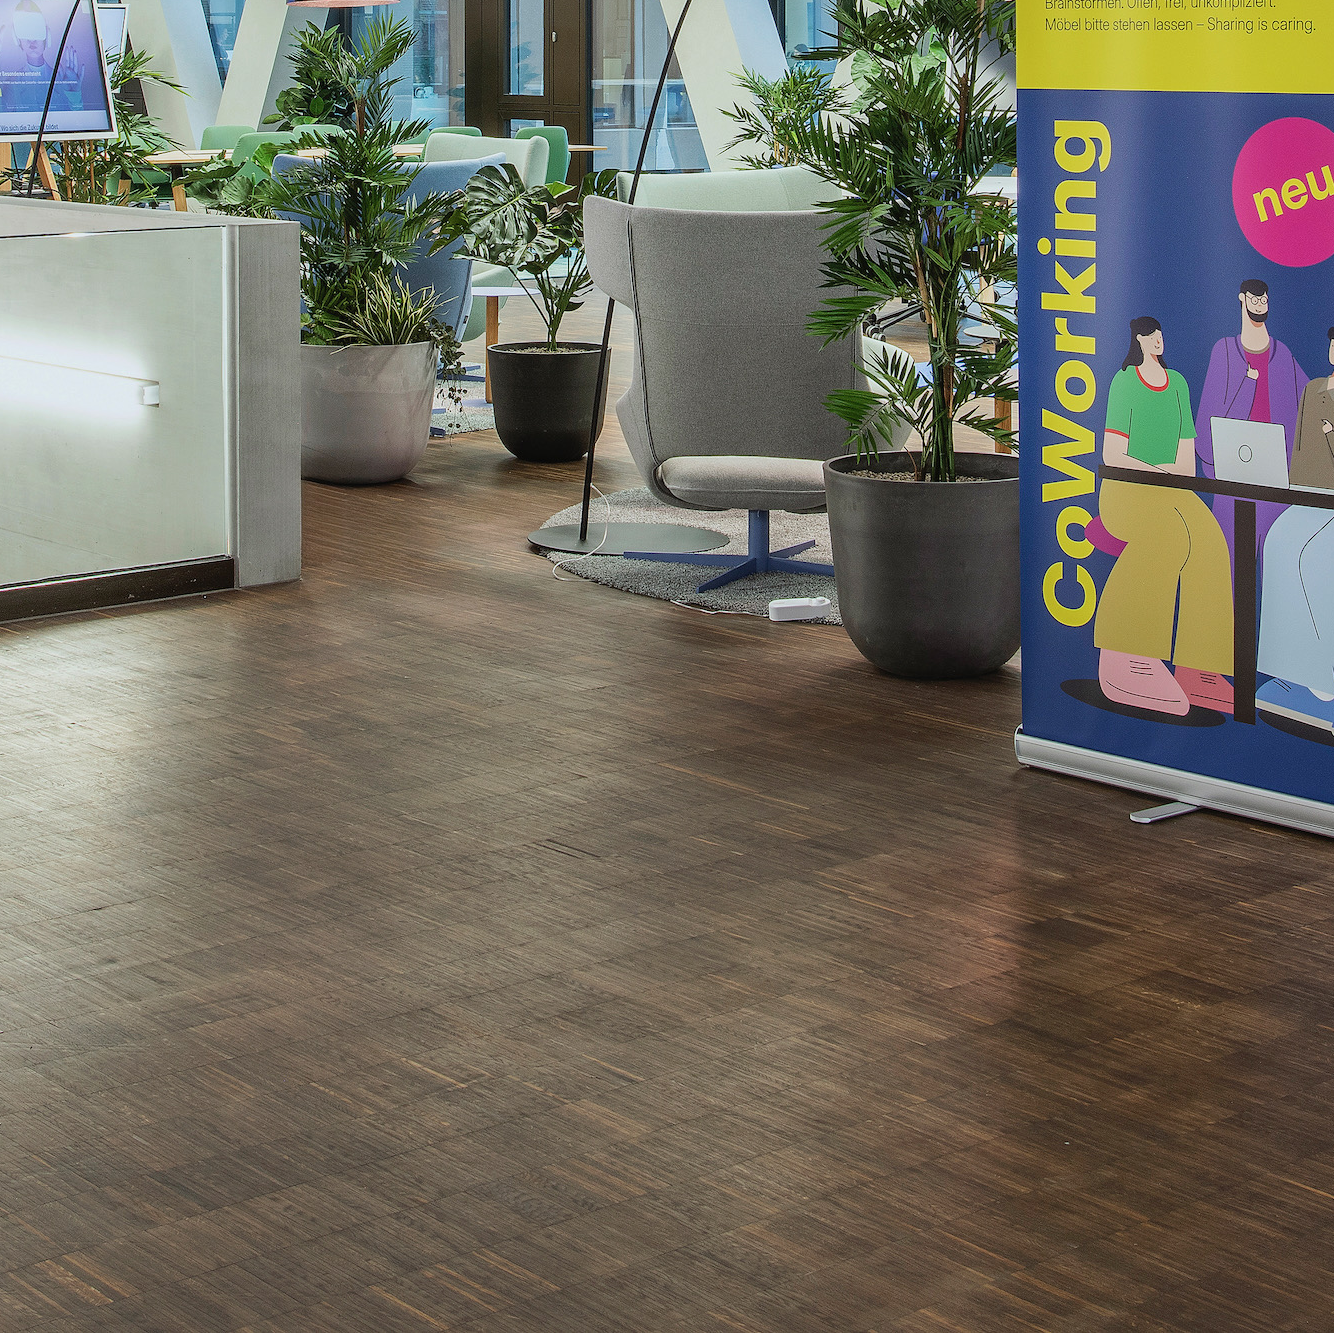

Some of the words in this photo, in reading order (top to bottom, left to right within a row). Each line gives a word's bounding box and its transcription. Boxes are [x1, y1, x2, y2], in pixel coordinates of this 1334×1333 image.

[1045, 18, 1081, 31] Möbel
[1084, 18, 1110, 31] bitte
[1112, 18, 1150, 31] stehen
[1153, 18, 1193, 31] lassen
[1207, 16, 1254, 34] Sharing
[1257, 17, 1268, 31] is
[1271, 17, 1316, 34] caring.
[1037, 119, 1112, 628] CoWorking
